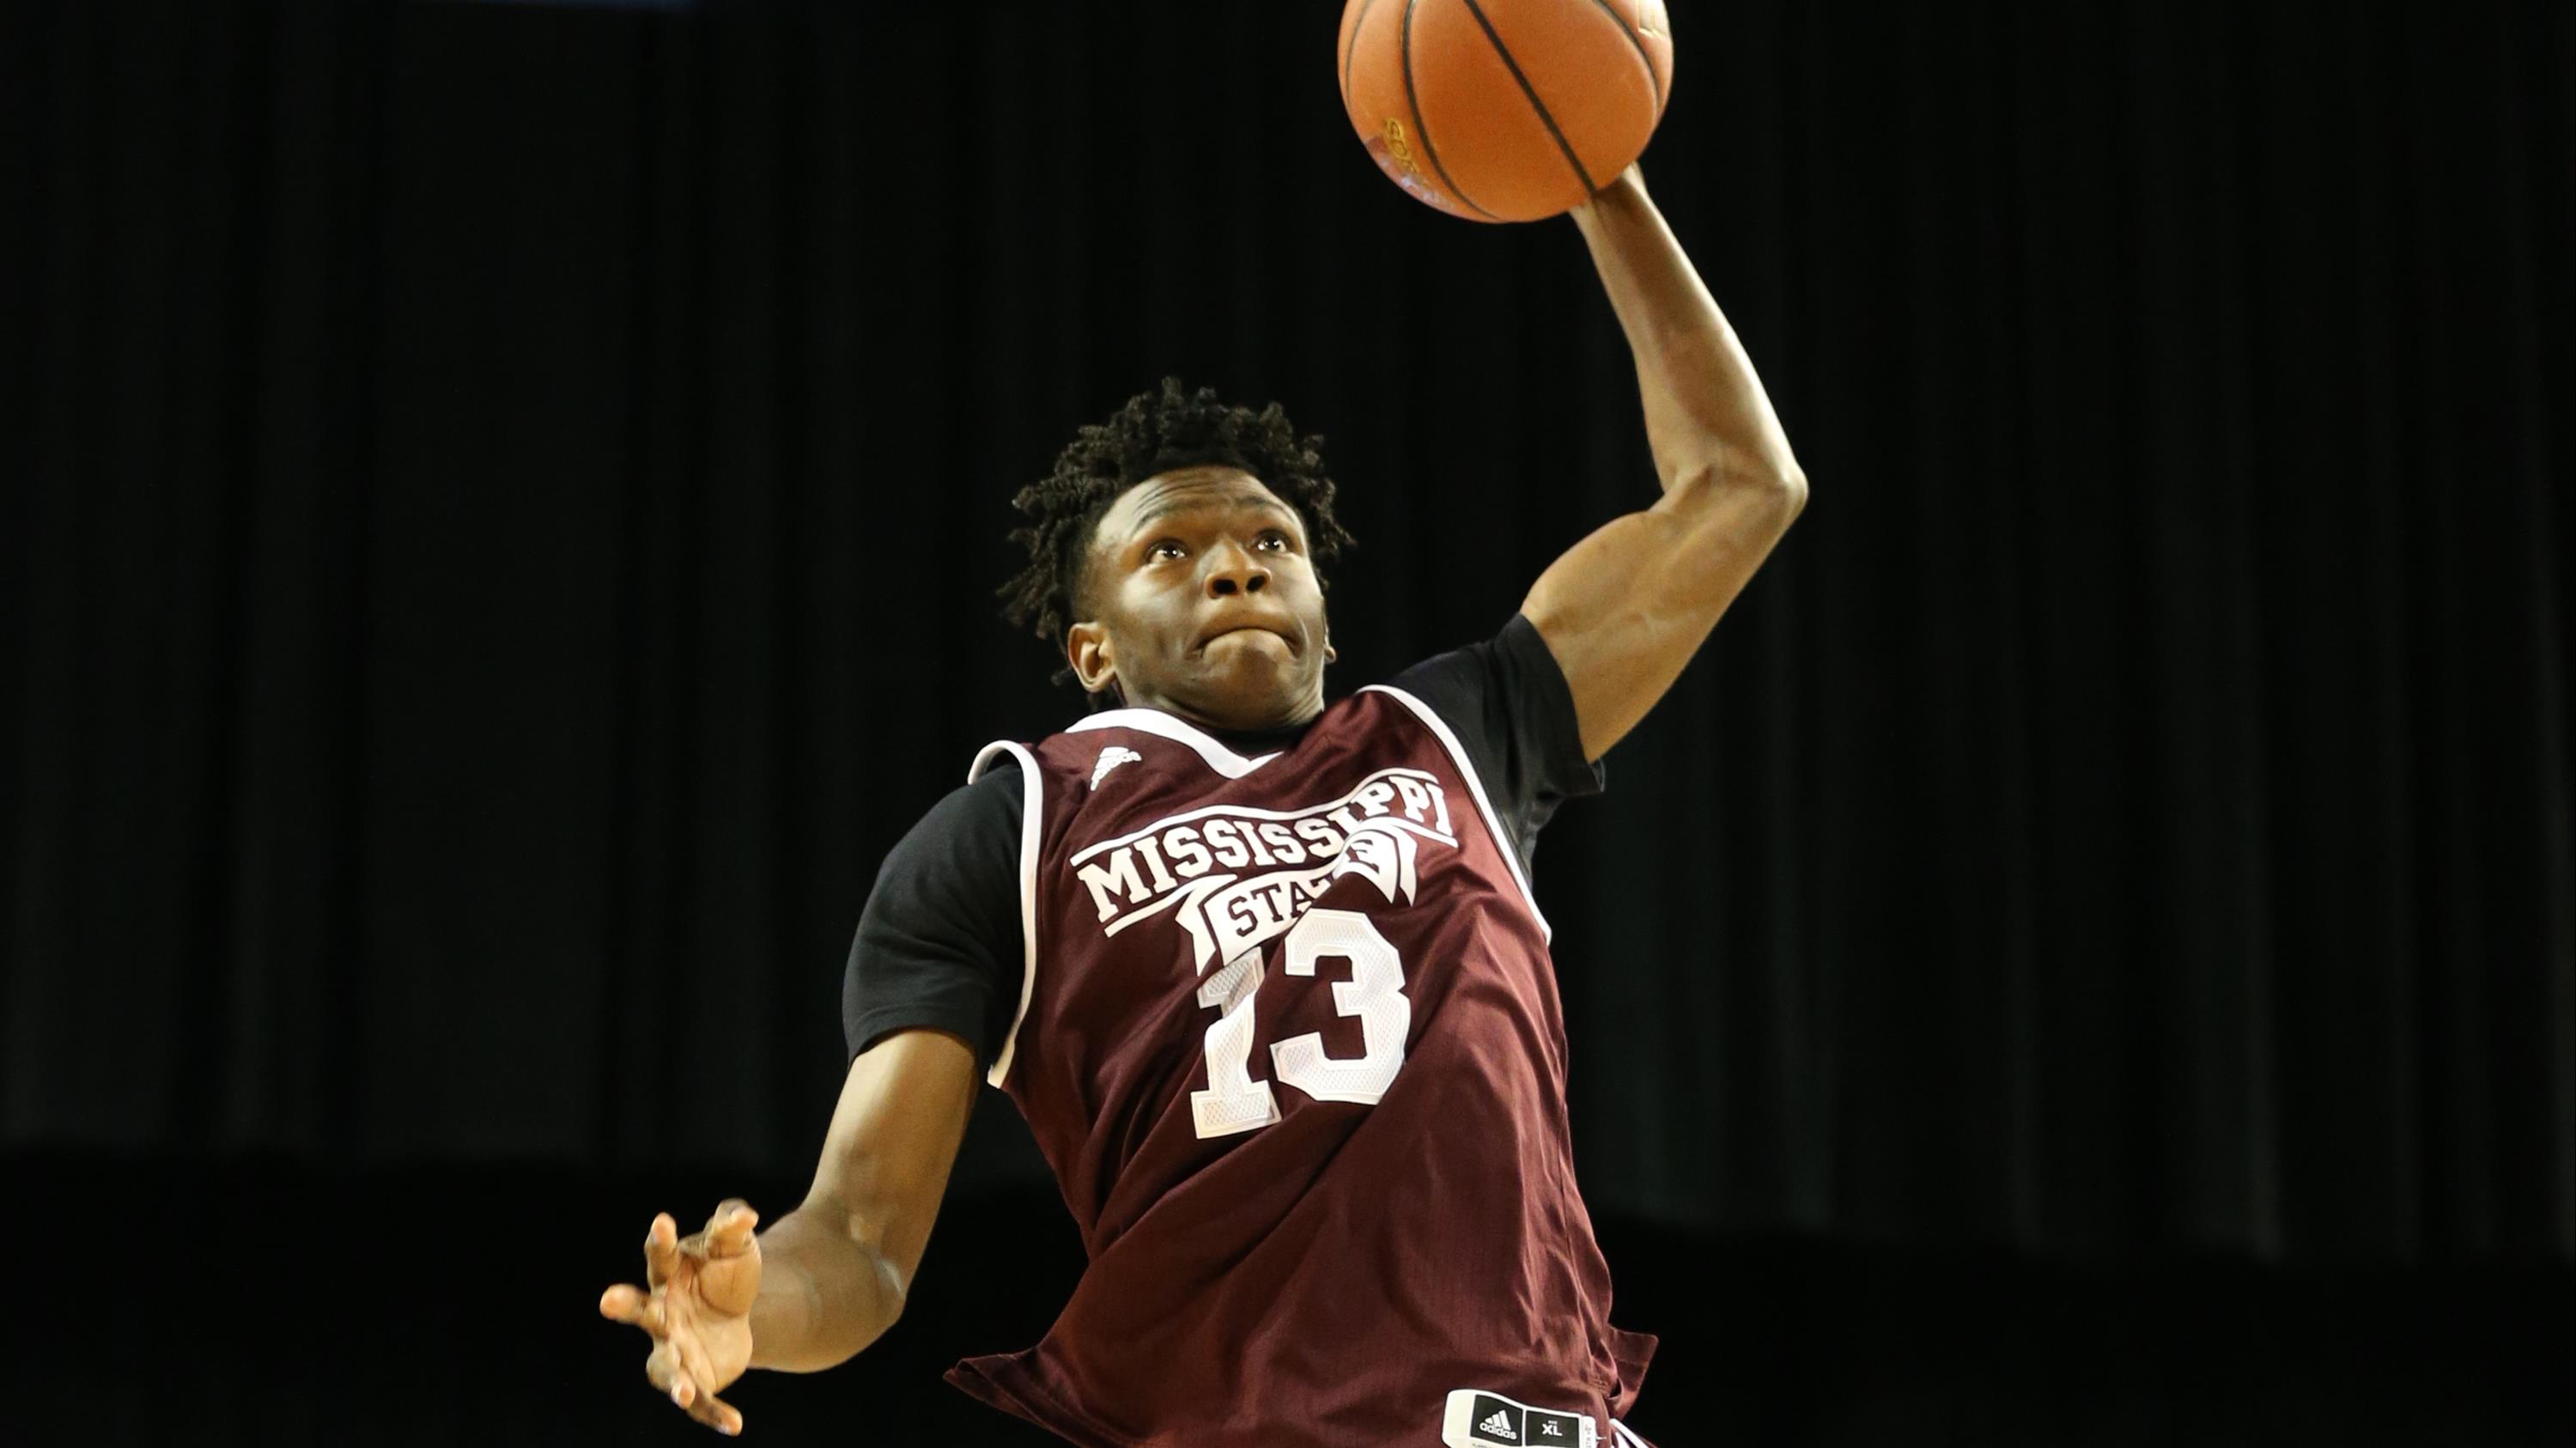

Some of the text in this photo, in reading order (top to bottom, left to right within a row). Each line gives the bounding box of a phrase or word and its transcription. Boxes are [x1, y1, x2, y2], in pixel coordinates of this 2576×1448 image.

[1077, 776, 1453, 923] MISSISSIPPI
[1190, 908, 1412, 1139] 13
[1479, 1422, 1517, 1440] adidas
[1542, 1423, 1563, 1436] XL
